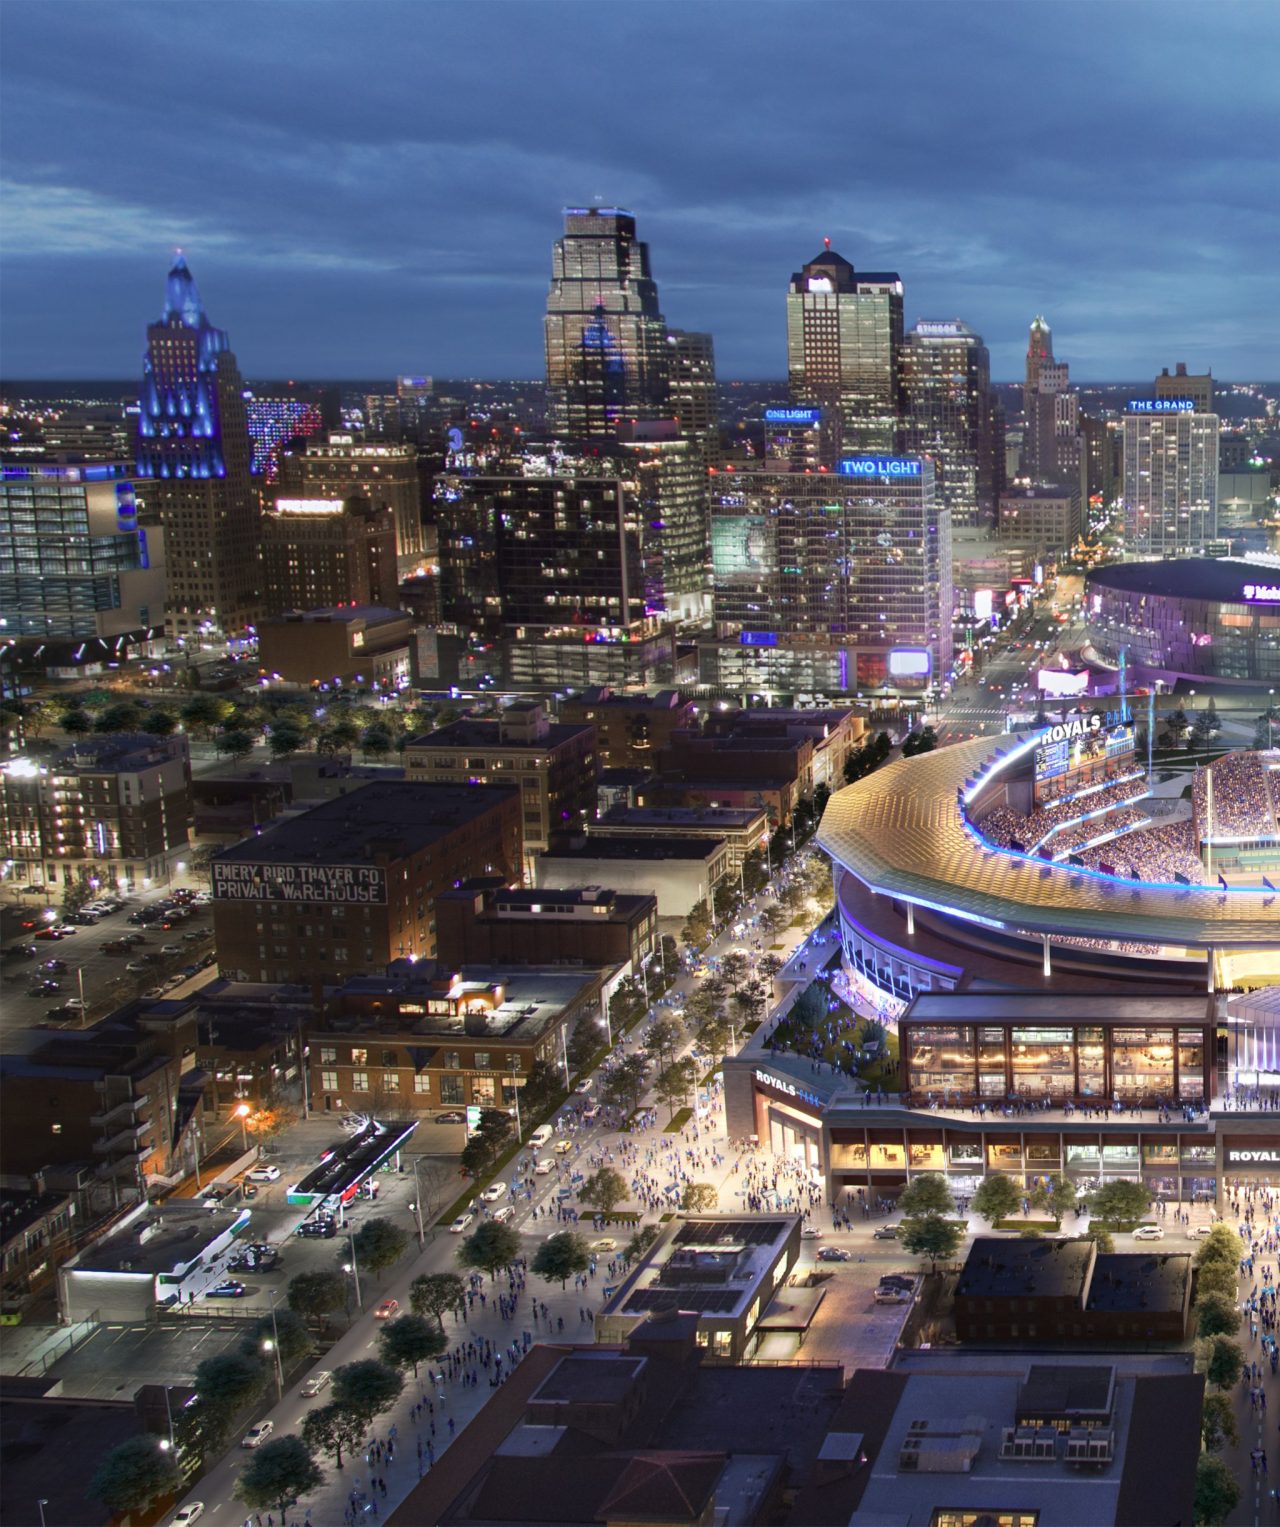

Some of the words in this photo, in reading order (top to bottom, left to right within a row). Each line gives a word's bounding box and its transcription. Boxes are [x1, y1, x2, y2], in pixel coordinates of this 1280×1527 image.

[766, 410, 785, 419] ONE
[786, 410, 812, 419] LIGHT
[1130, 401, 1153, 409] THE
[1154, 401, 1194, 409] GRAND
[842, 461, 875, 474] TWO
[878, 461, 919, 475] LIGHT
[1041, 715, 1101, 745] ROYALS
[214, 864, 258, 880] EMERY
[298, 867, 354, 884] THAYER
[281, 883, 379, 903] WAREHOUSE
[755, 1069, 796, 1096] ROYALS
[799, 1088, 820, 1108] PARK
